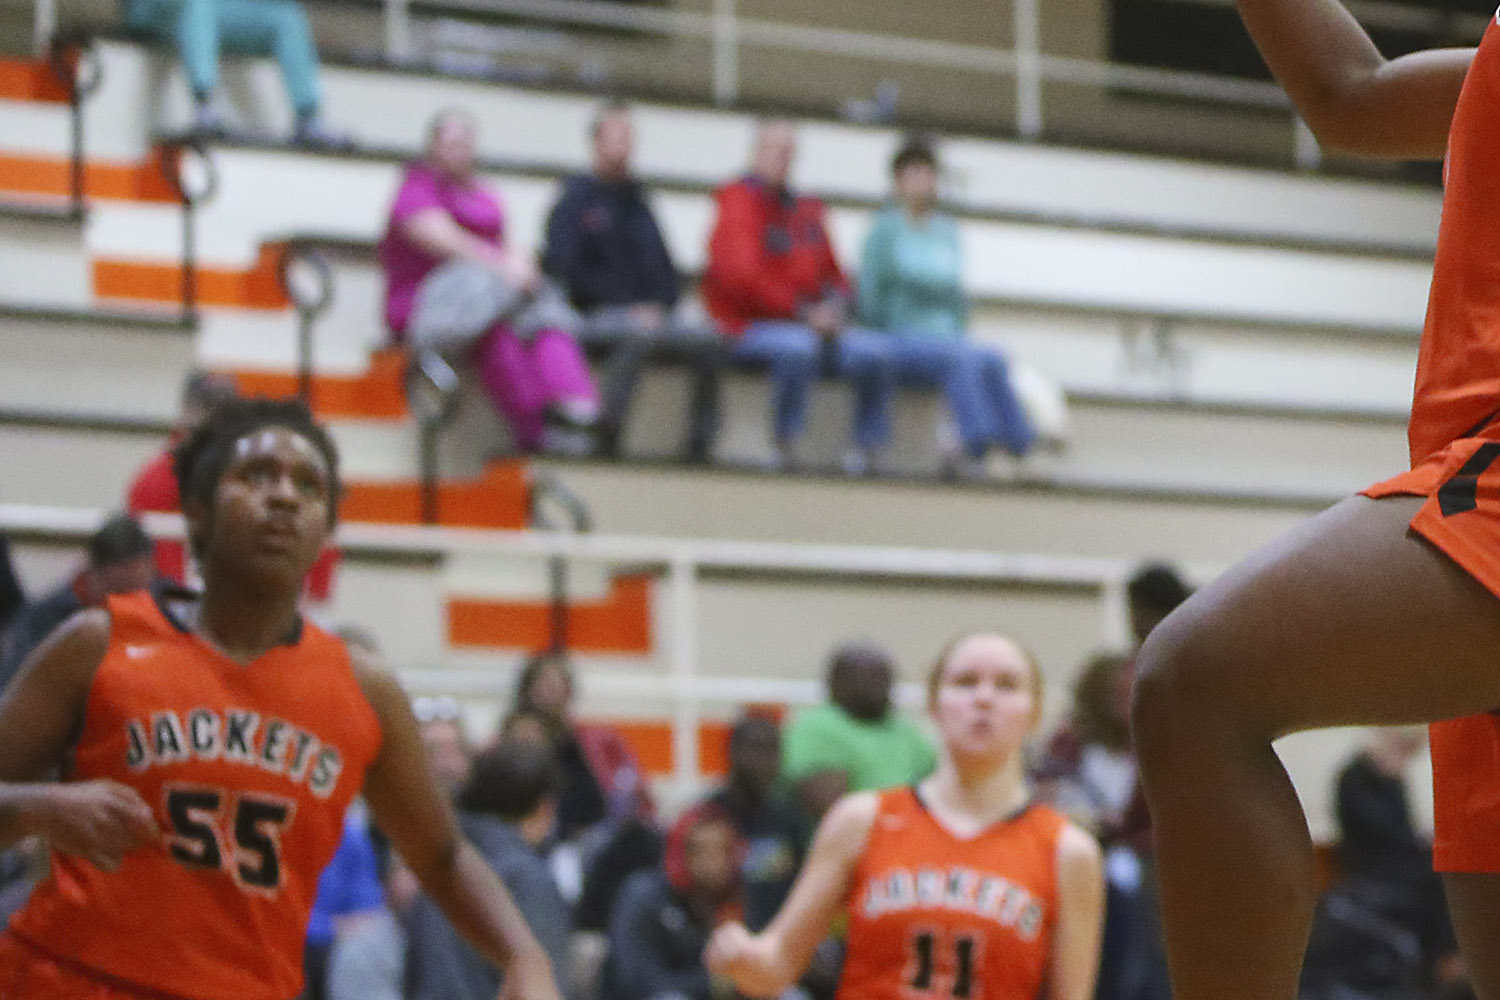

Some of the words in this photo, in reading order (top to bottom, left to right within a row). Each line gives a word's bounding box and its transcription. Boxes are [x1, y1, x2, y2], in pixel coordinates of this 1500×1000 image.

[125, 708, 344, 798] JACKETS
[162, 781, 295, 897] 55
[908, 928, 981, 1000] 11
